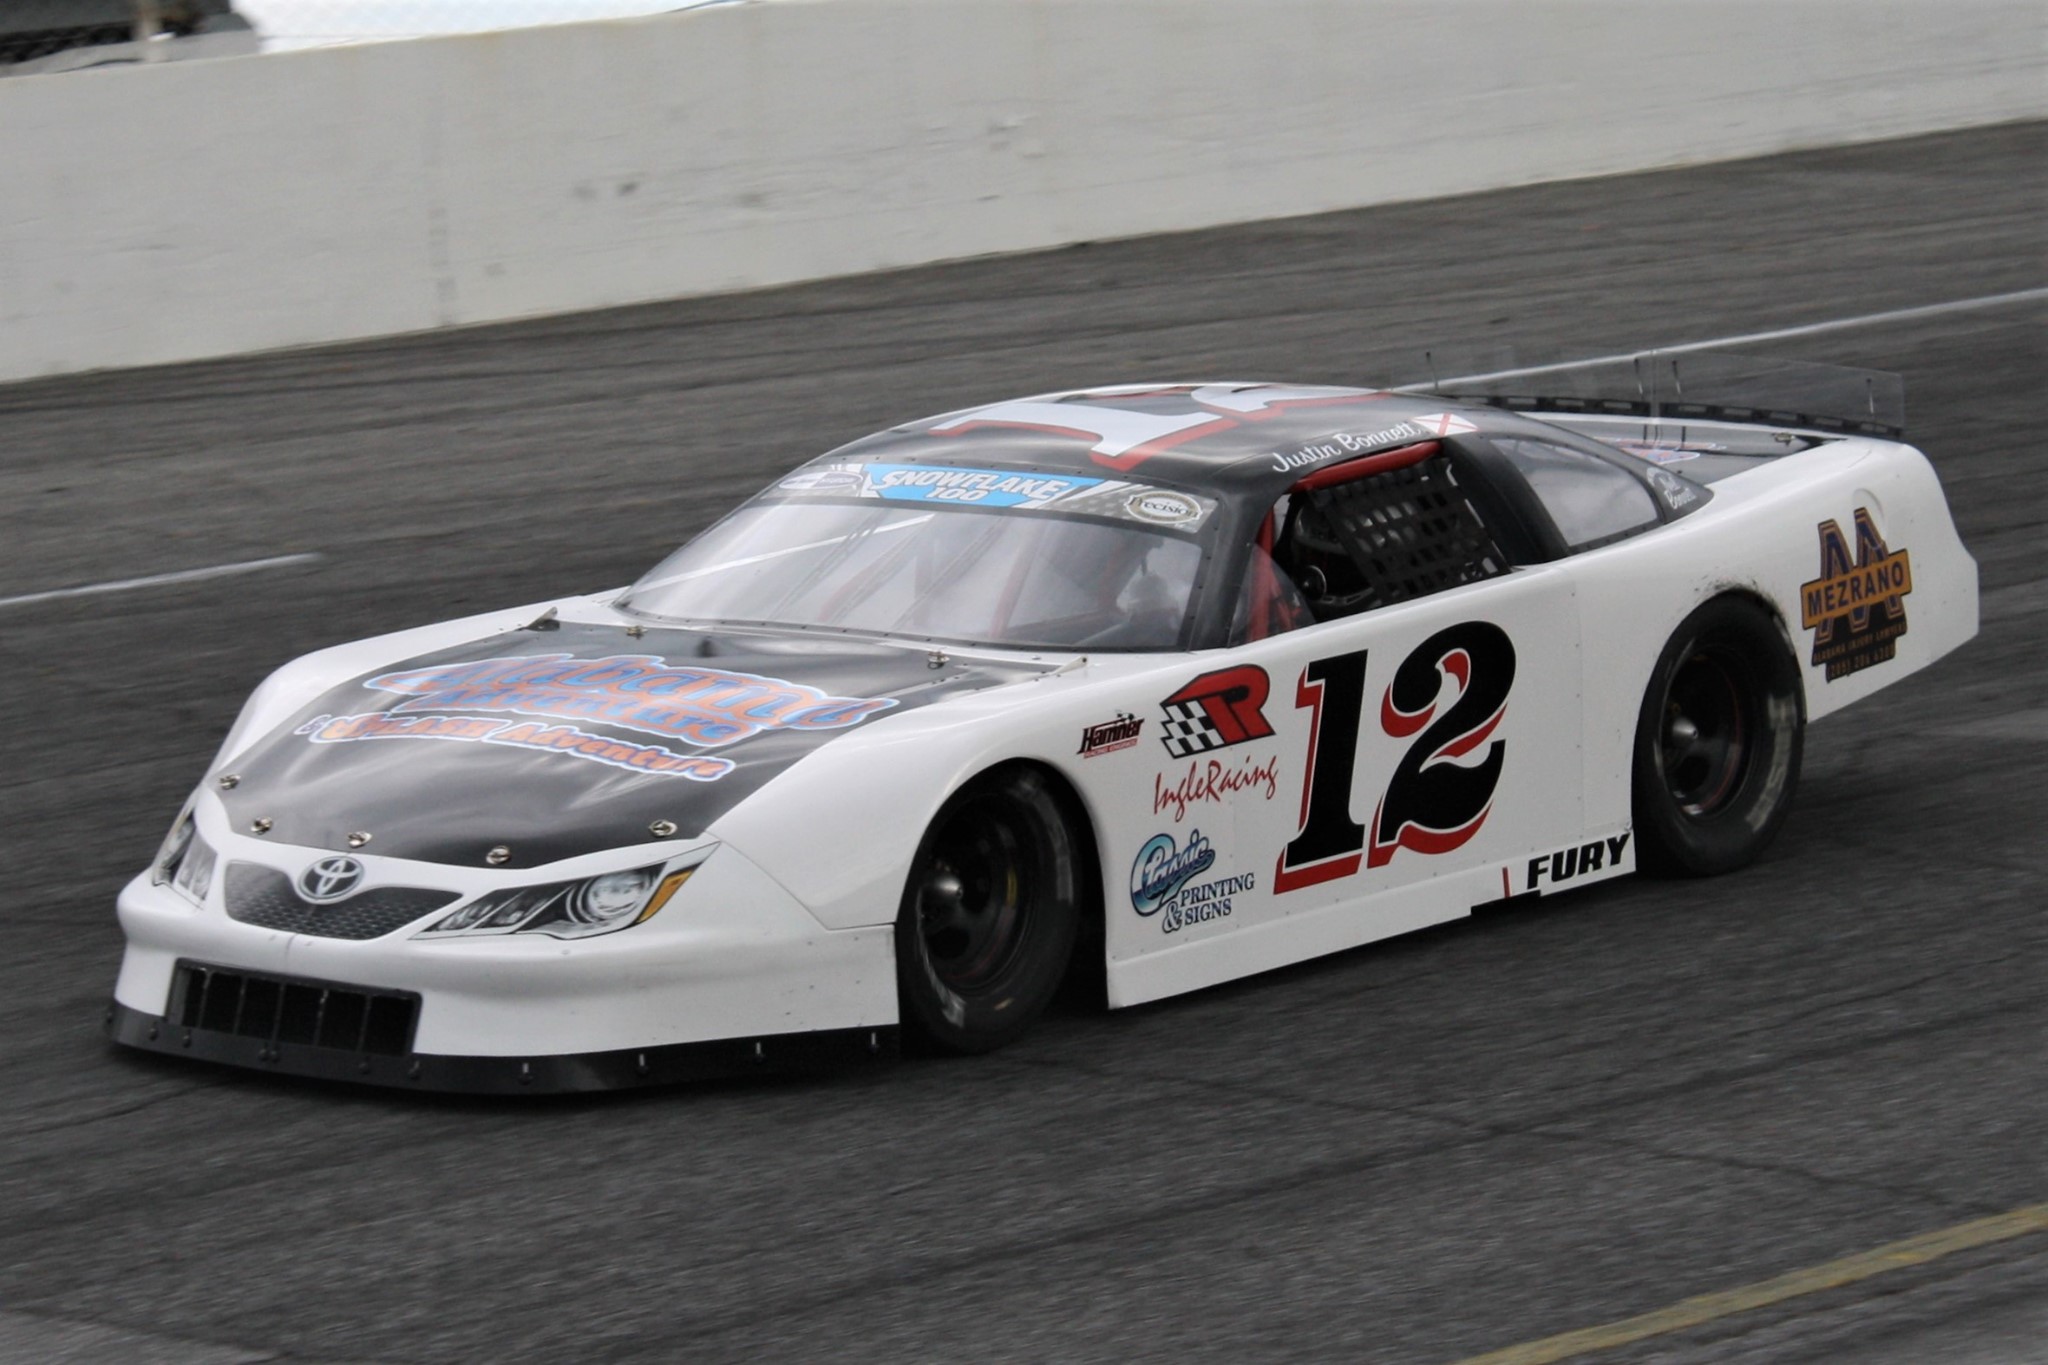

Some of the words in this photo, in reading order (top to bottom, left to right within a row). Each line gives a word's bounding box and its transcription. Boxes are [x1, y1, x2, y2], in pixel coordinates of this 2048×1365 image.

[1272, 444, 1342, 473] Justin
[1332, 422, 1422, 451] Bonnett
[868, 470, 1072, 500] SNOWFLAKE
[924, 486, 990, 501] 100
[1128, 495, 1200, 519] Precision
[1807, 561, 1904, 617] MEZRANO
[390, 681, 765, 747] Adventure
[482, 723, 736, 782] Adventure
[1273, 620, 1517, 895] 12
[1527, 832, 1632, 890] FURY
[1180, 872, 1255, 907] PRINTING
[1162, 900, 1183, 934] &
[1184, 898, 1232, 926] SIGNS
